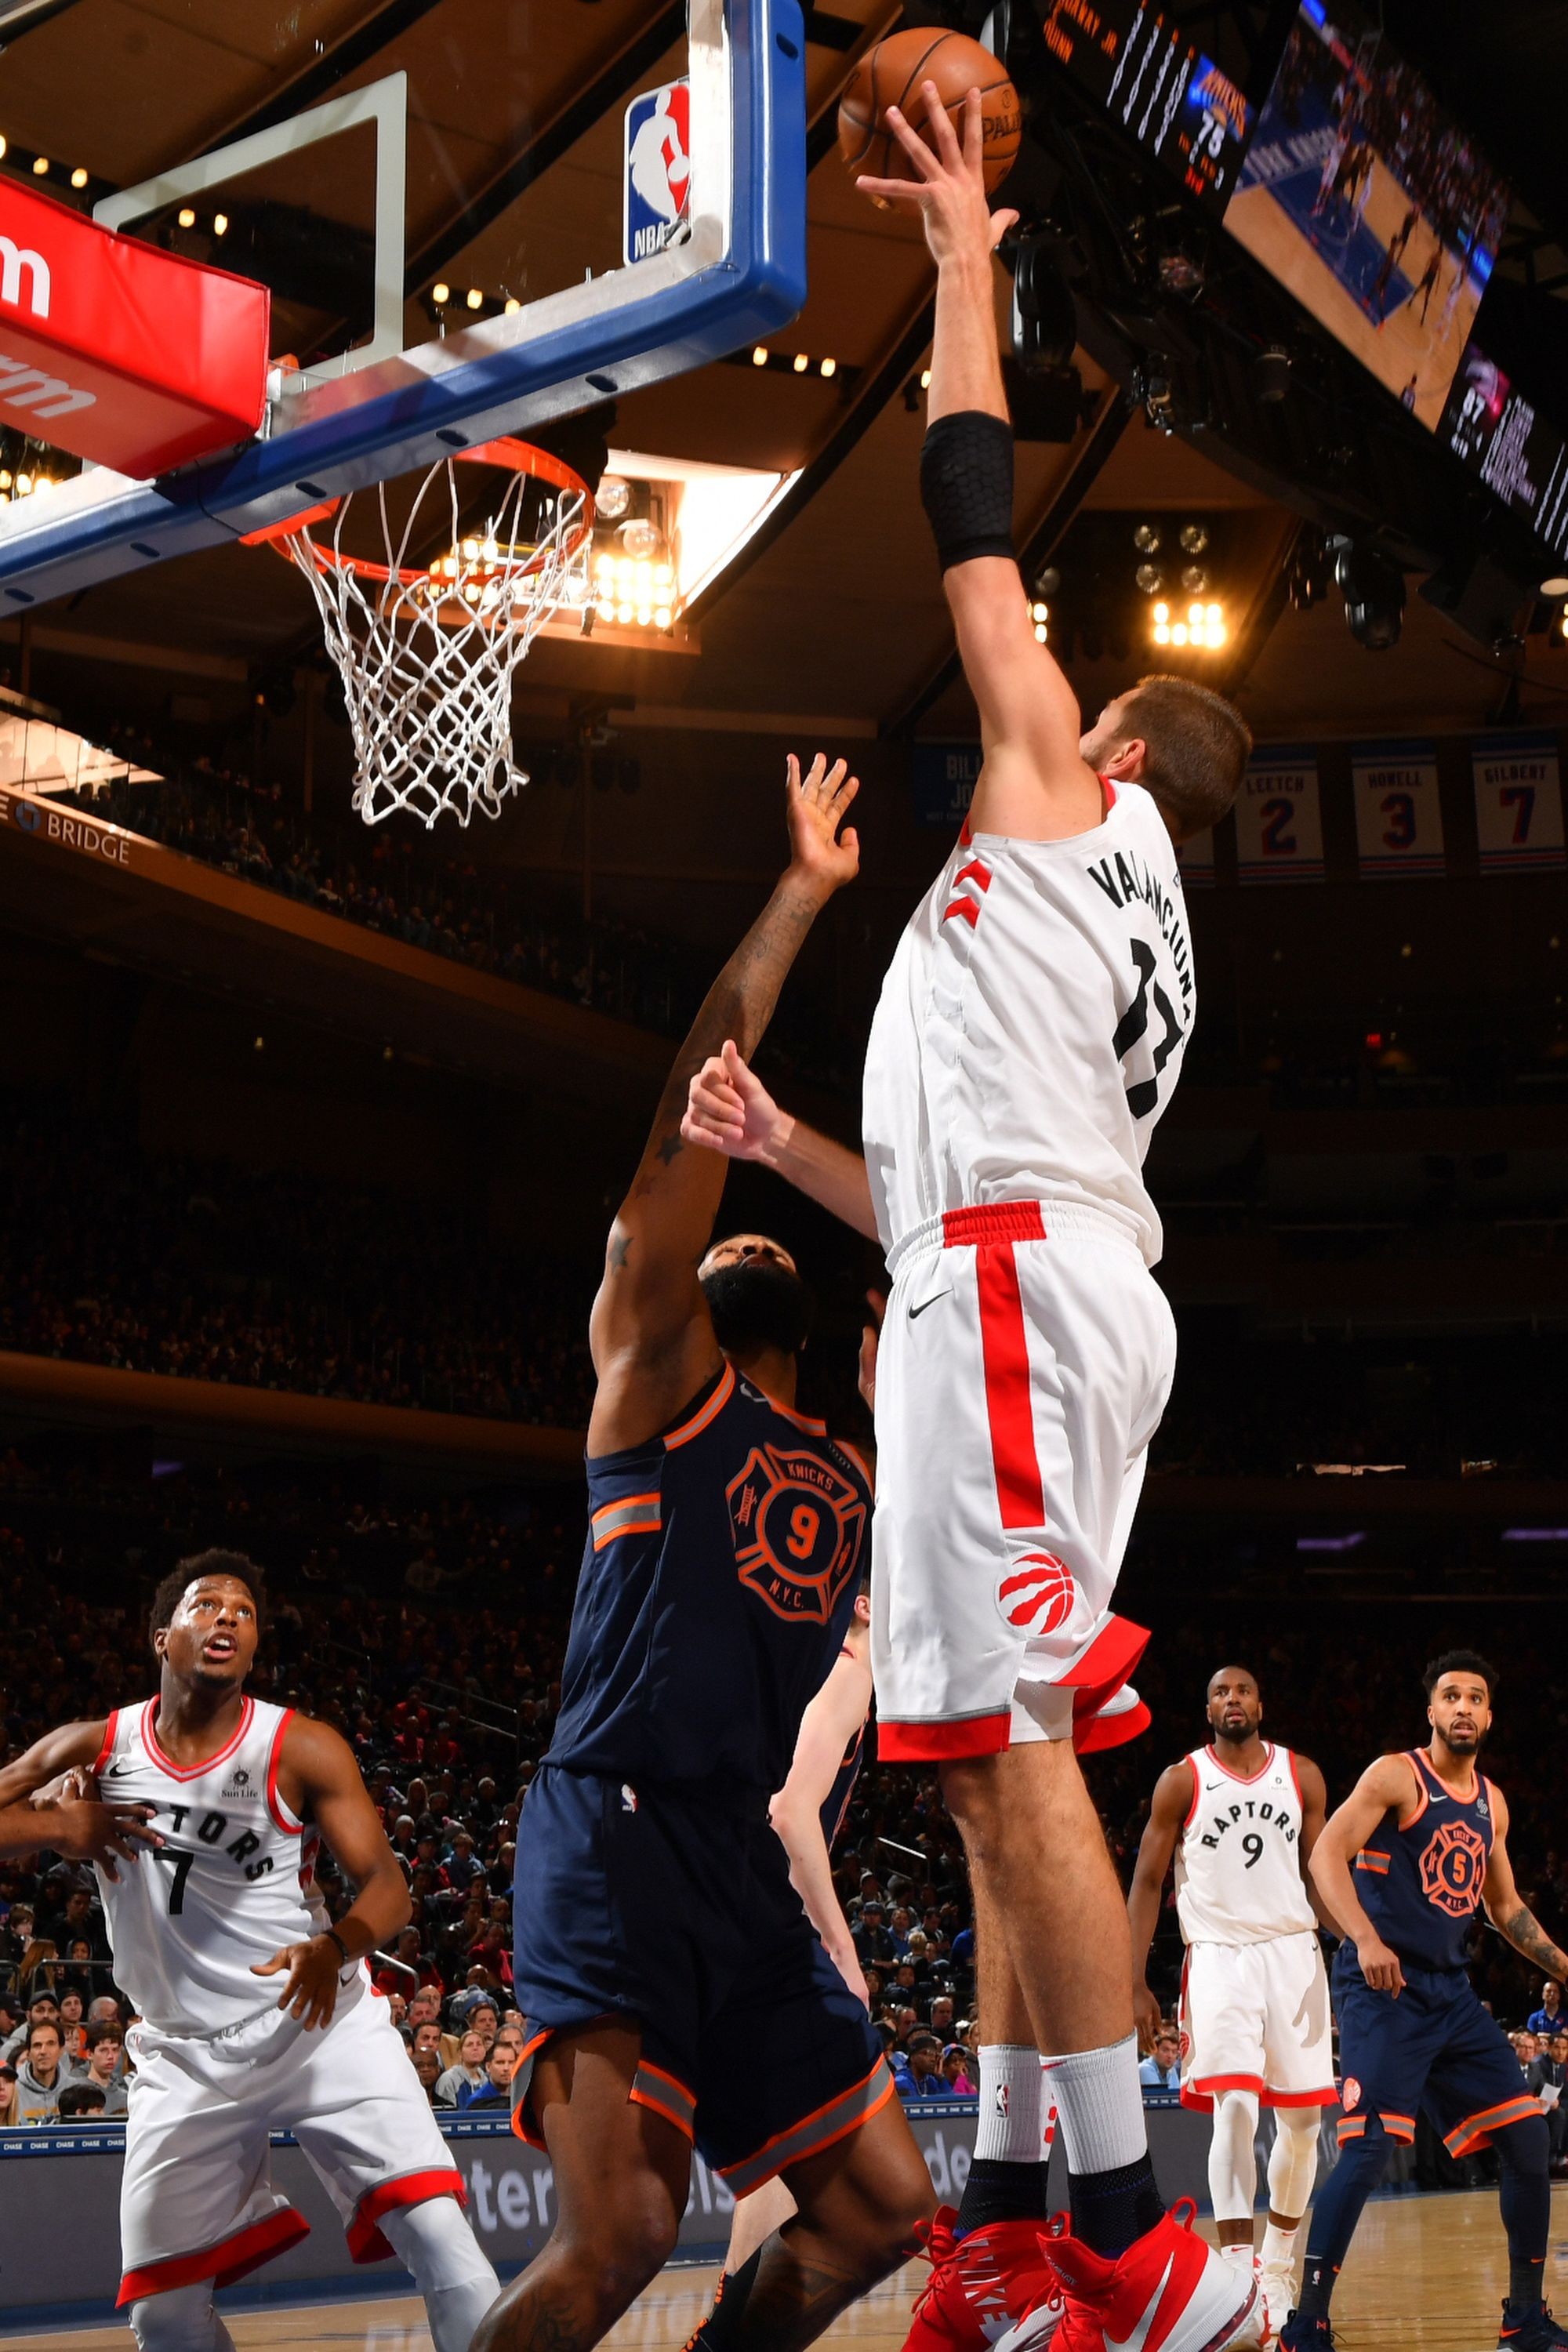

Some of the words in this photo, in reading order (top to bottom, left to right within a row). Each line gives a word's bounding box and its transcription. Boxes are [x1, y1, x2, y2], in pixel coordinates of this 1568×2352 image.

[47, 812, 129, 863] BRIDGE
[1260, 798, 1297, 856] 2
[1380, 792, 1417, 851] 3
[1499, 786, 1536, 845] 7
[786, 1462, 834, 1490] KNICKS
[786, 1504, 820, 1559] 9
[221, 1789, 238, 1798] Sun
[241, 1789, 258, 1798] Life
[1201, 1801, 1295, 1849] RAPTORS
[1242, 1833, 1263, 1870] 9
[153, 1849, 194, 1915] 7
[1452, 1851, 1466, 1884] 5
[463, 2158, 554, 2232] ter
